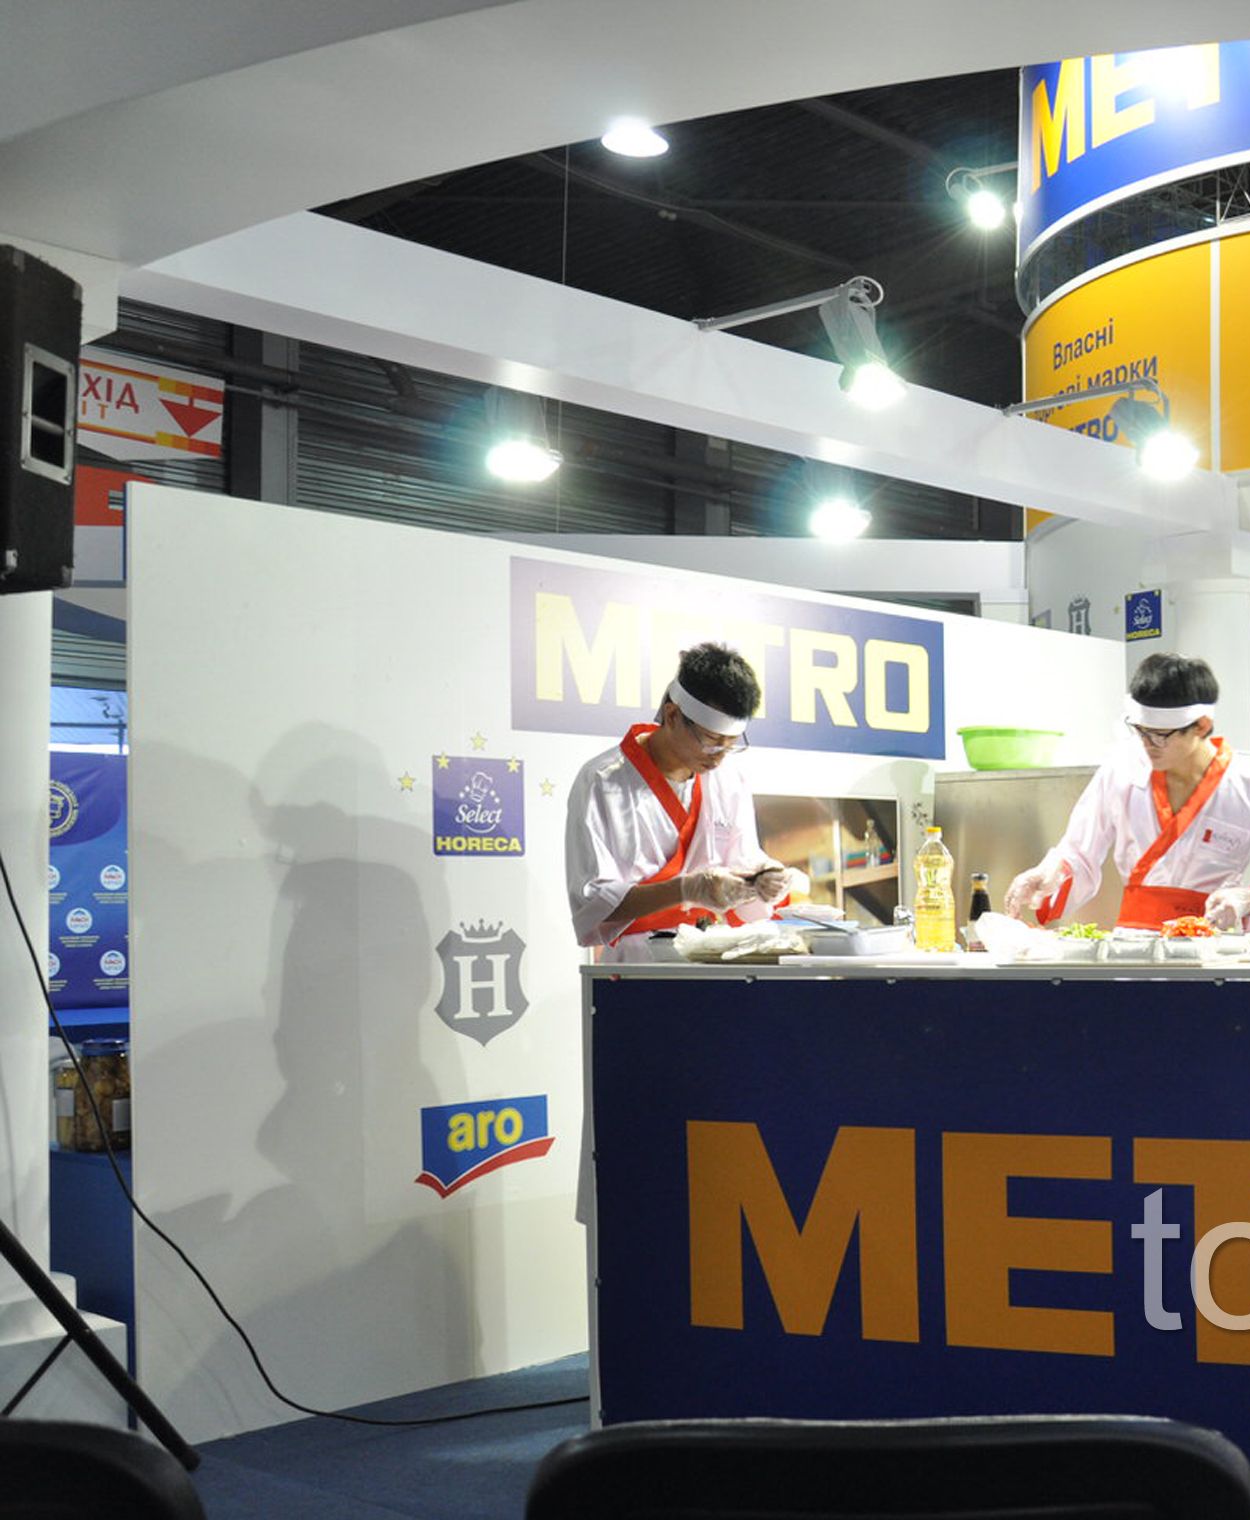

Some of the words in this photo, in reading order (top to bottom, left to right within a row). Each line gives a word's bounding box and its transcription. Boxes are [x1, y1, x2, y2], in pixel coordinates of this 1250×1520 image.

[1053, 317, 1114, 371] Власні
[1087, 355, 1158, 388] марки
[1069, 413, 1119, 443] TRO
[455, 803, 503, 824] Select
[436, 835, 522, 852] HORECA
[453, 953, 513, 1019] H
[447, 1107, 524, 1152] aro
